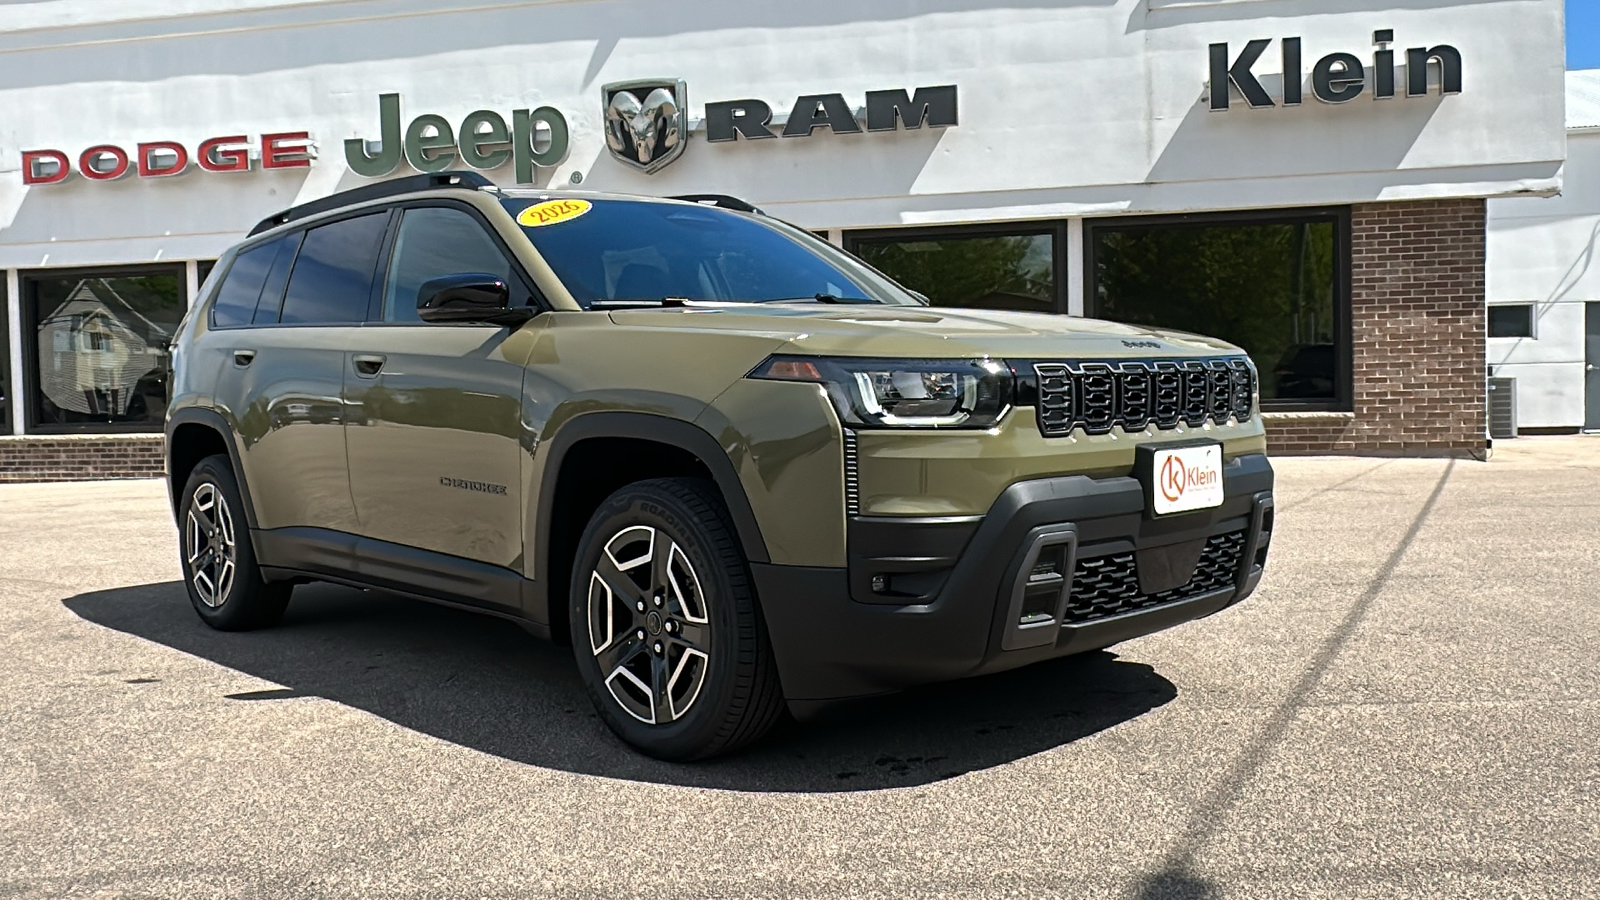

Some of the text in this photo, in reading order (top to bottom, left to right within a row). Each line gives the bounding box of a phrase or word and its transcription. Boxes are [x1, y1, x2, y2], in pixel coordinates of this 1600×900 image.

[1208, 28, 1462, 112] Klein
[344, 92, 569, 184] Jeep
[704, 84, 959, 143] RAM
[22, 131, 311, 186] DODGE
[530, 201, 580, 223] 2026
[440, 476, 507, 496] CHEROKEE
[1187, 466, 1217, 487] Klein
